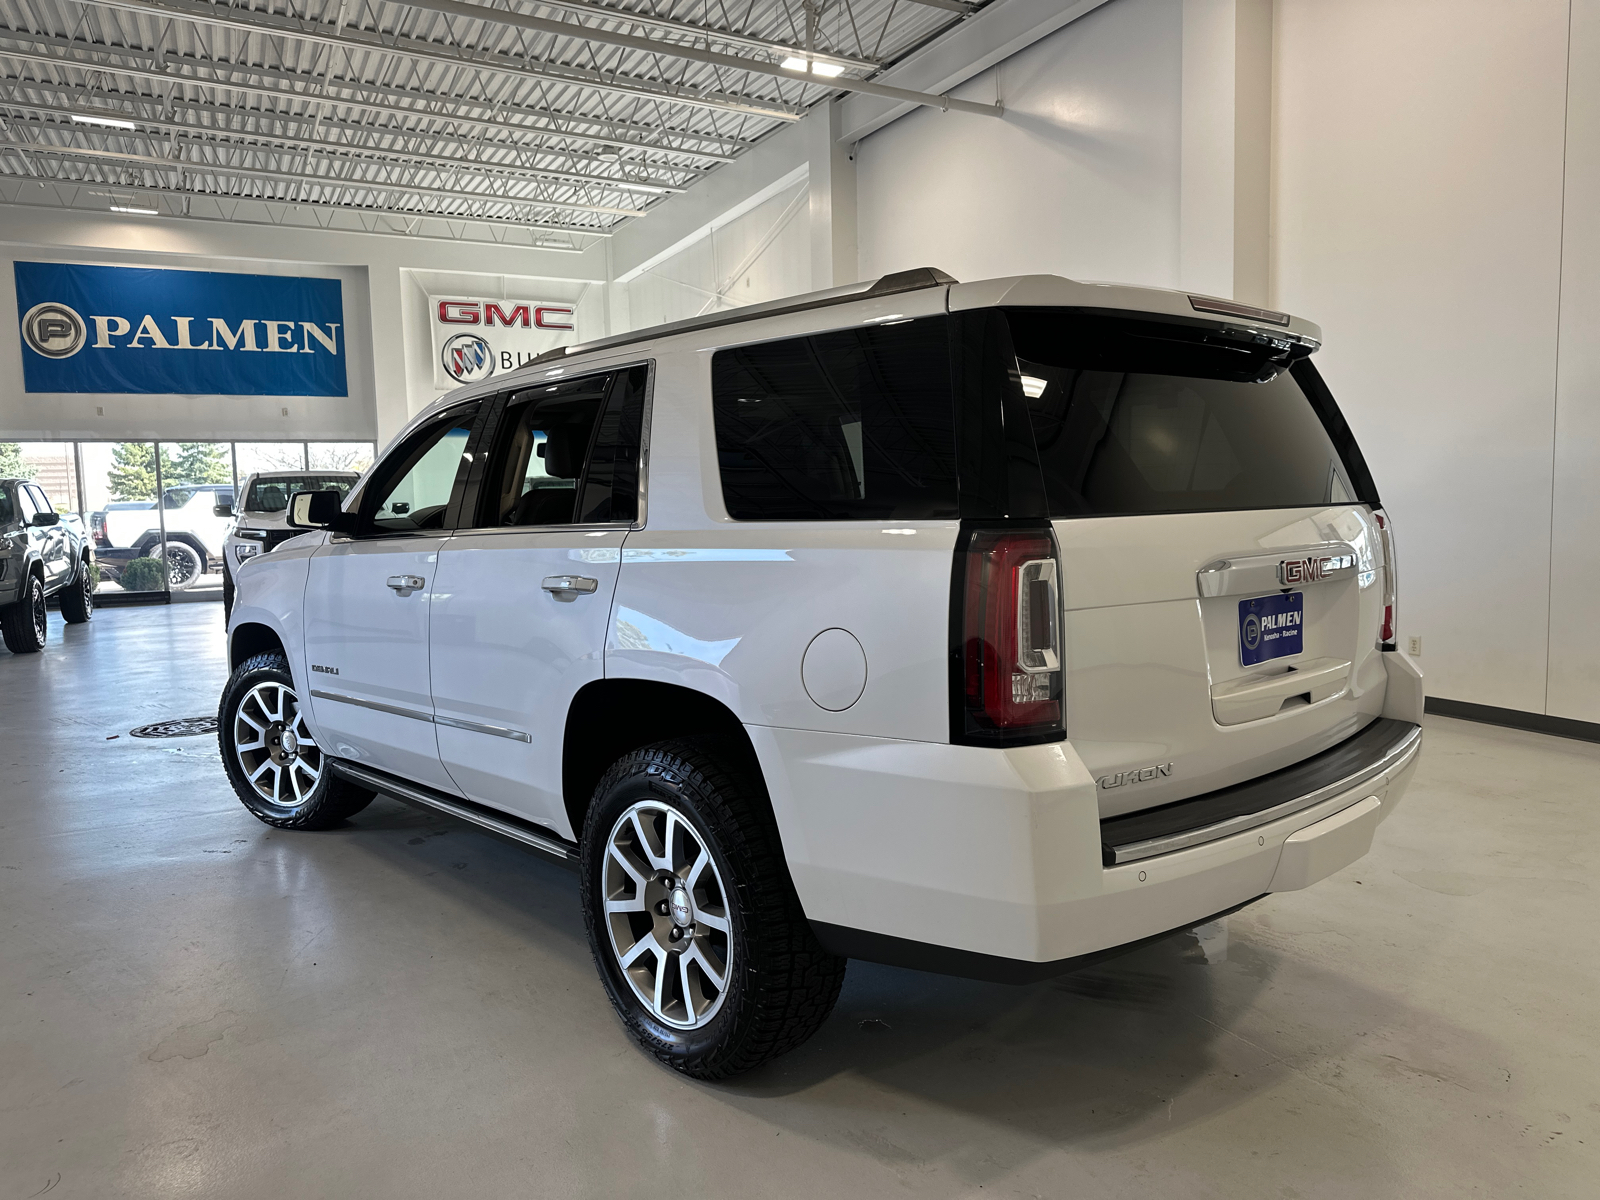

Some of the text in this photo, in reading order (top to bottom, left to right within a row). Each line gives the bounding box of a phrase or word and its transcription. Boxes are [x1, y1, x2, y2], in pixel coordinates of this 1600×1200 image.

[438, 300, 574, 331] GMC
[89, 314, 341, 355] PALMEN
[1285, 557, 1333, 583] GMC
[1261, 610, 1301, 631] PALMEN
[1282, 629, 1298, 637] Racine
[640, 1028, 674, 1050] 275/55
